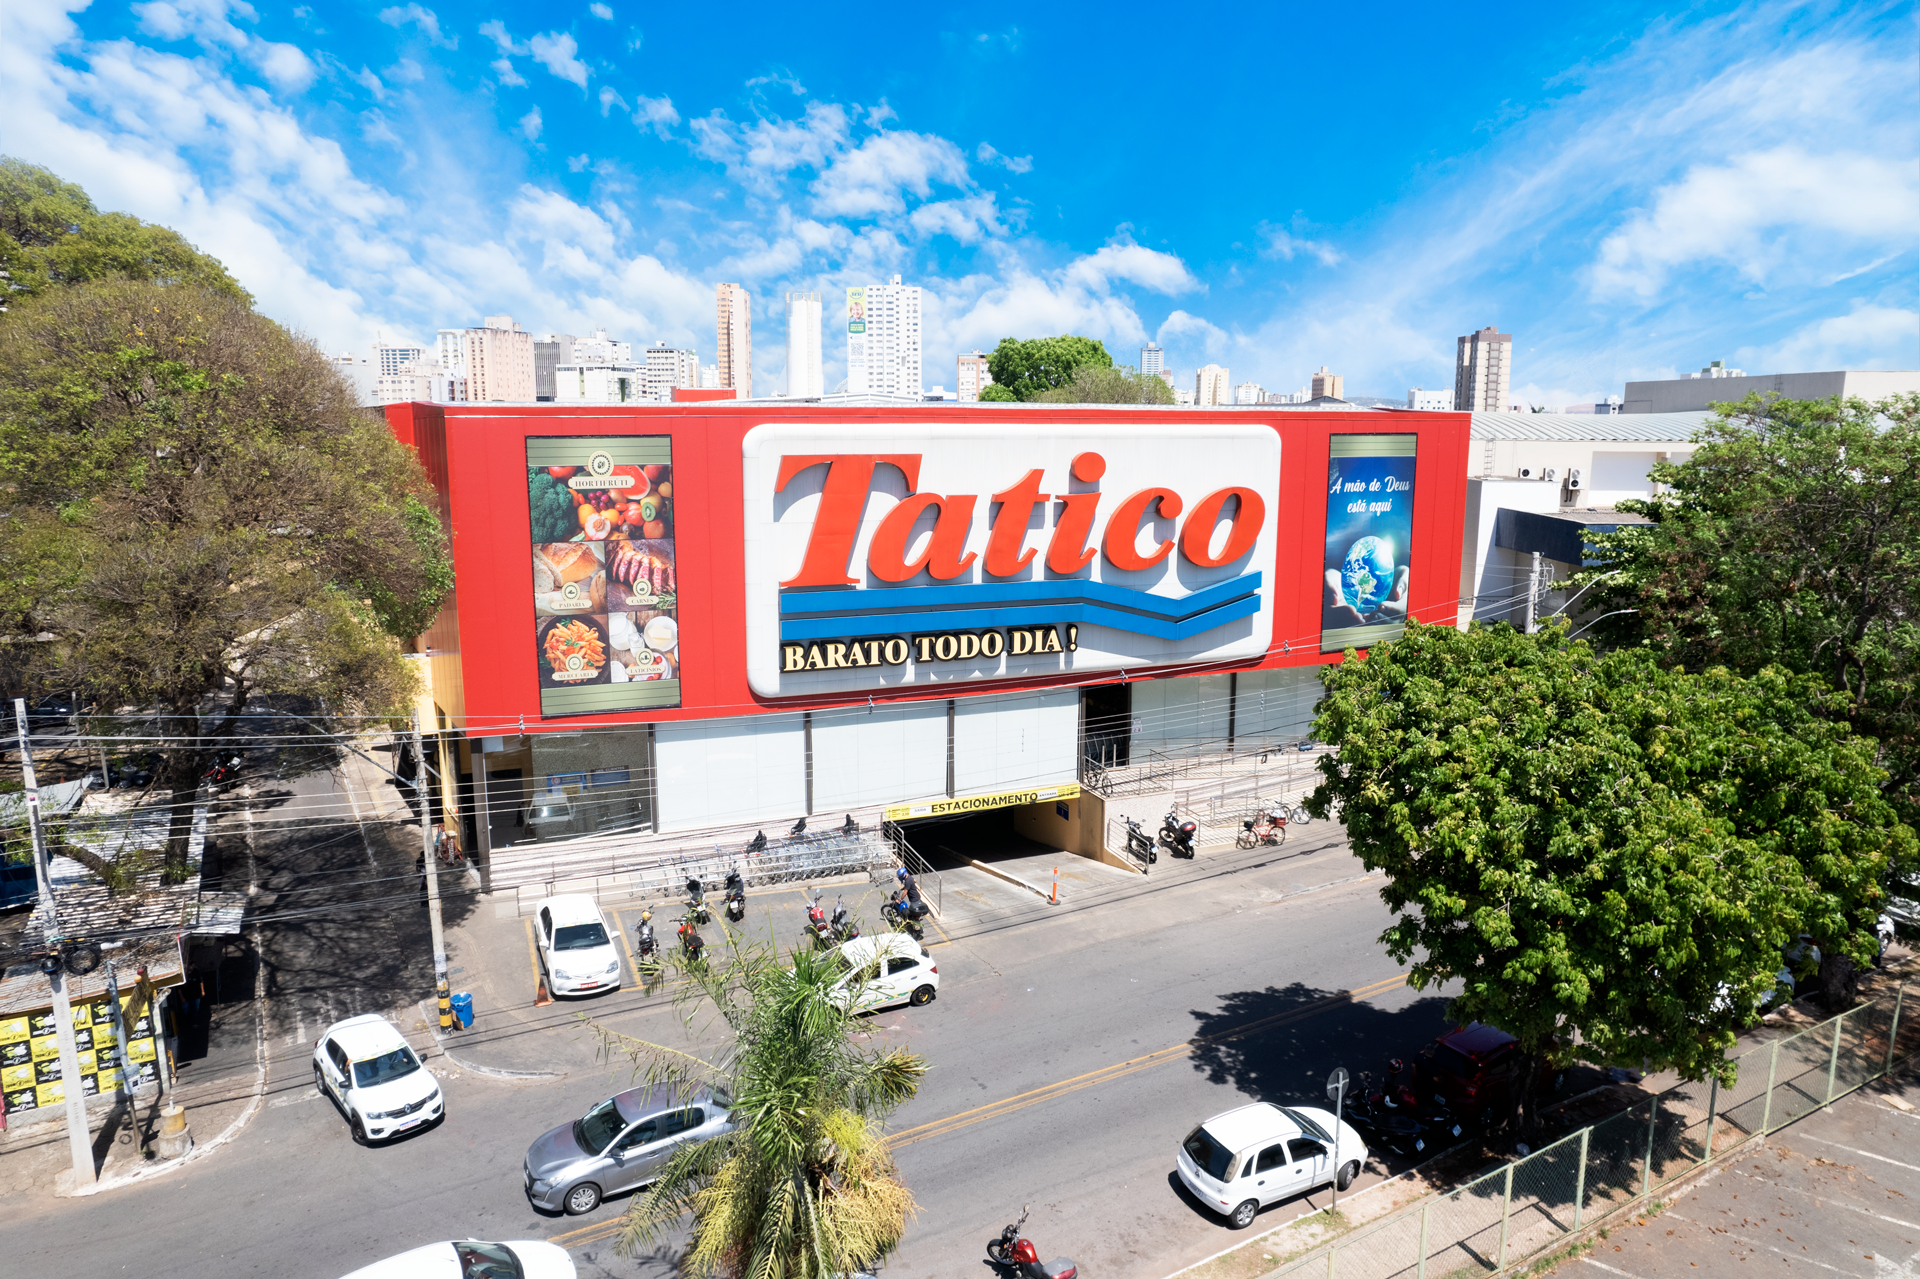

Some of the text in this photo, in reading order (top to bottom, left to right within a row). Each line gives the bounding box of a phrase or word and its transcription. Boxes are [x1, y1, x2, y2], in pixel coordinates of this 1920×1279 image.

[1330, 476, 1410, 494] A mão de Deus
[1347, 498, 1392, 516] está aqui
[773, 452, 1265, 587] Tatico
[781, 638, 909, 673] BARATO
[912, 629, 1004, 663] TODO
[930, 792, 1039, 814] ESTACIONAMENTO
